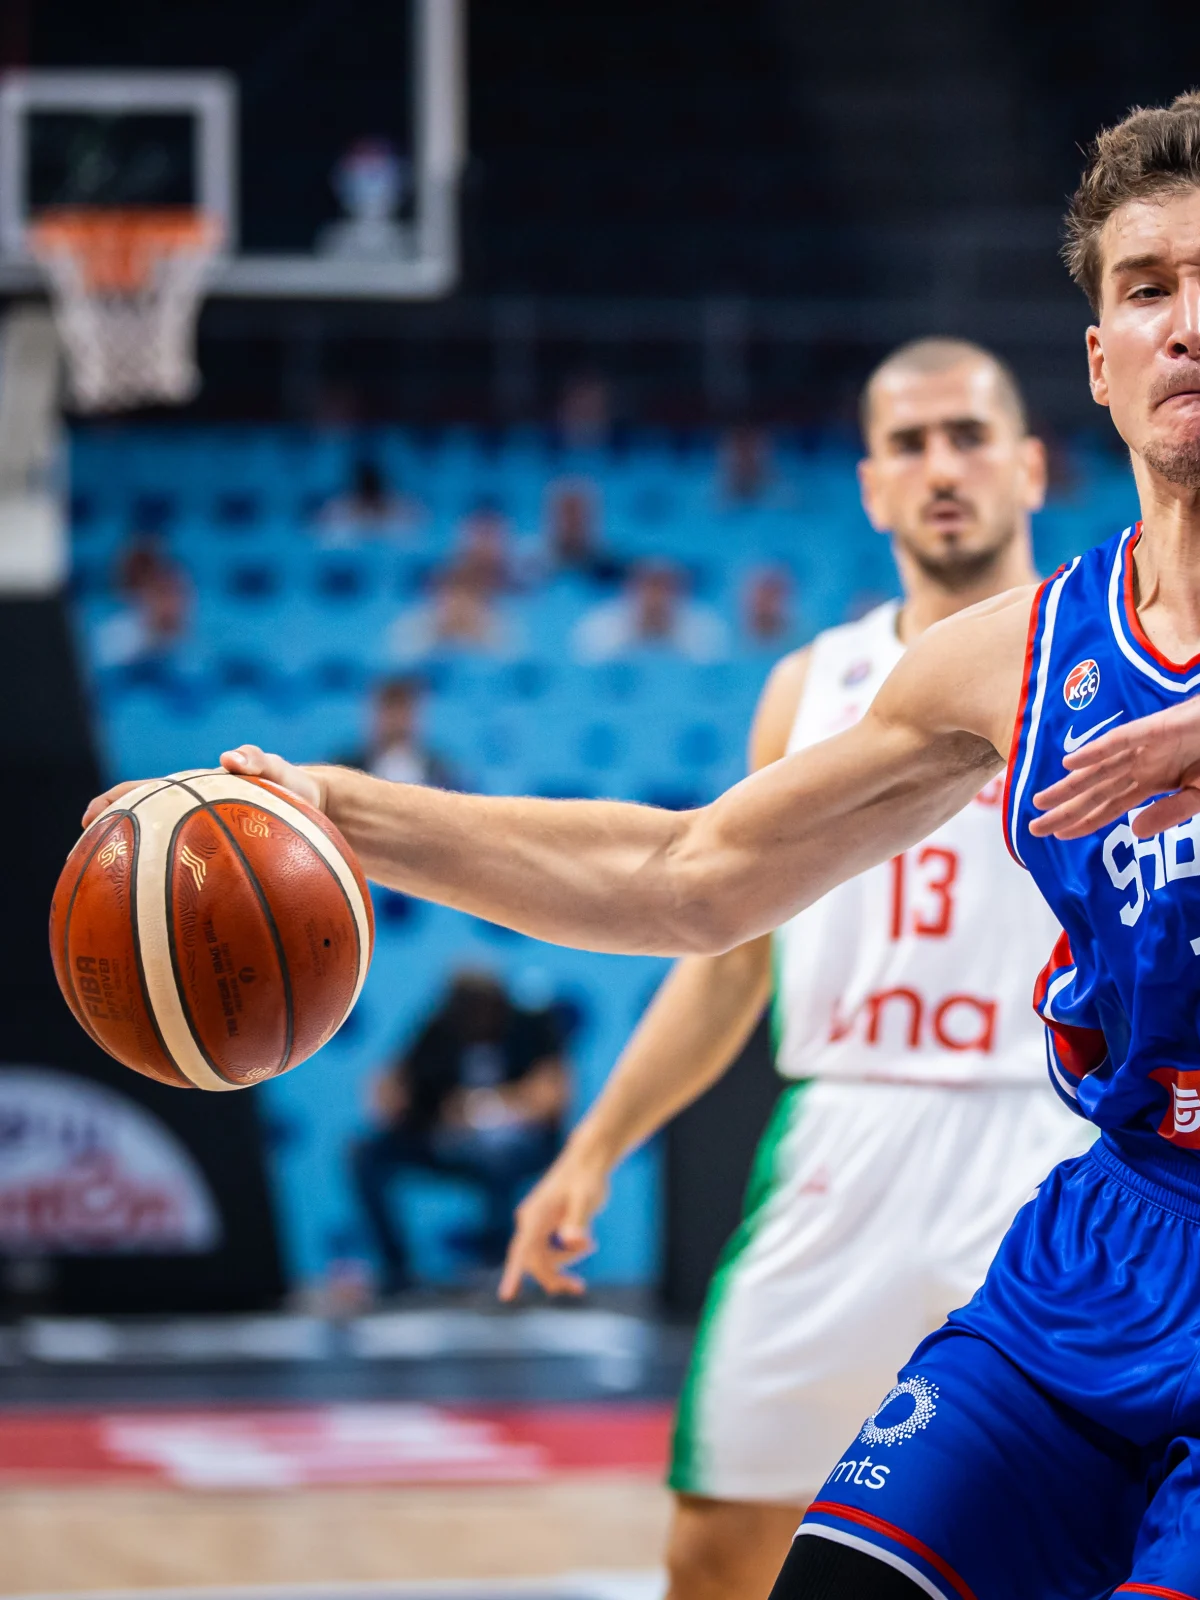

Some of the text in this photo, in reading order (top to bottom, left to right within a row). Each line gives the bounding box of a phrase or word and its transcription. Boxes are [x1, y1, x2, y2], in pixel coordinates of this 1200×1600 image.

[1069, 677, 1096, 700] KCC
[889, 846, 959, 941] 13
[76, 955, 109, 1019] FIBA
[827, 1456, 891, 1489] mts
